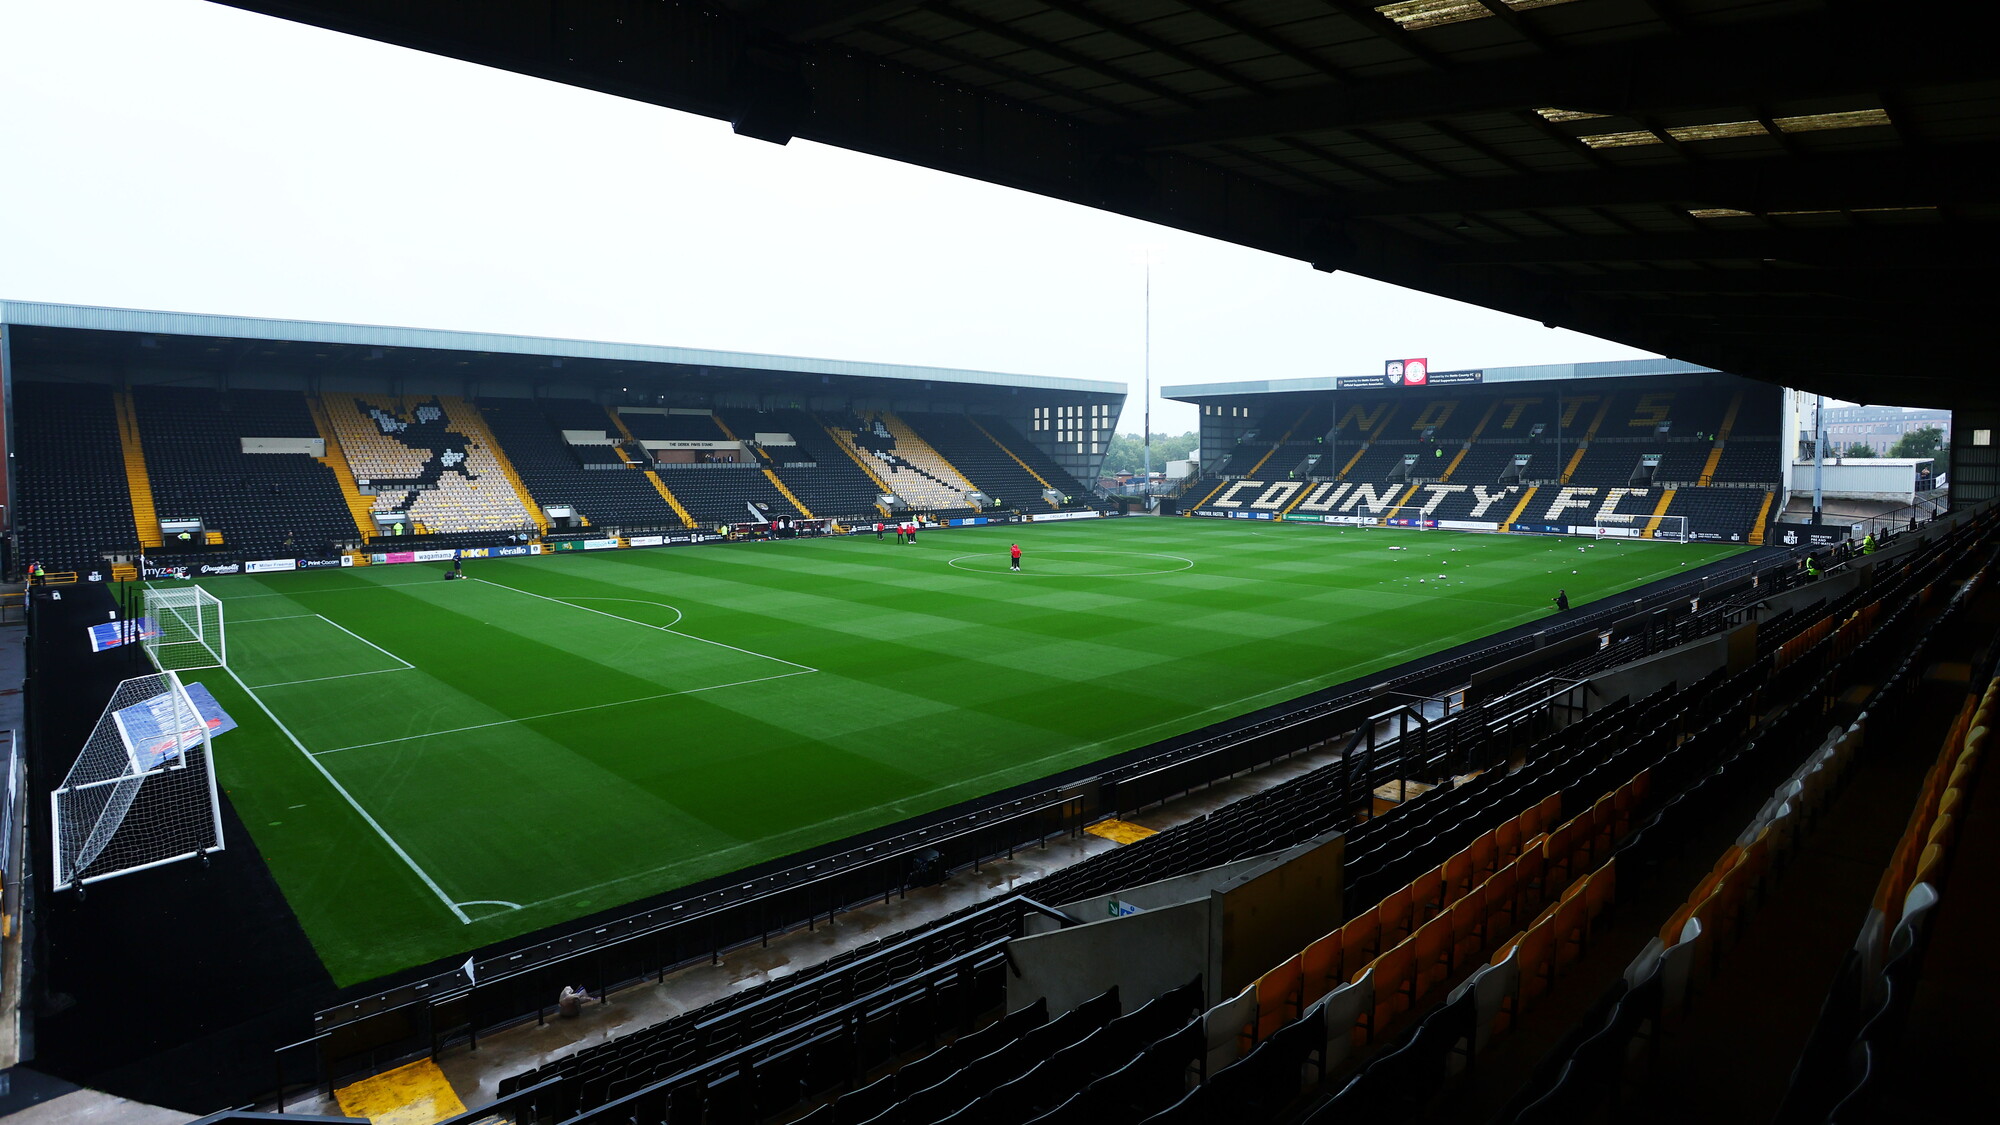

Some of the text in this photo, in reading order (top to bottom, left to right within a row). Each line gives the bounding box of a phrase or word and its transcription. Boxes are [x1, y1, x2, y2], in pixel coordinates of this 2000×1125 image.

[1335, 393, 1676, 431] NOTTS
[1213, 481, 1649, 523] COUNTY FC
[1784, 535, 1798, 545] NEST
[461, 548, 489, 558] MKM
[499, 547, 526, 556] Verallo
[145, 566, 187, 577] myzone
